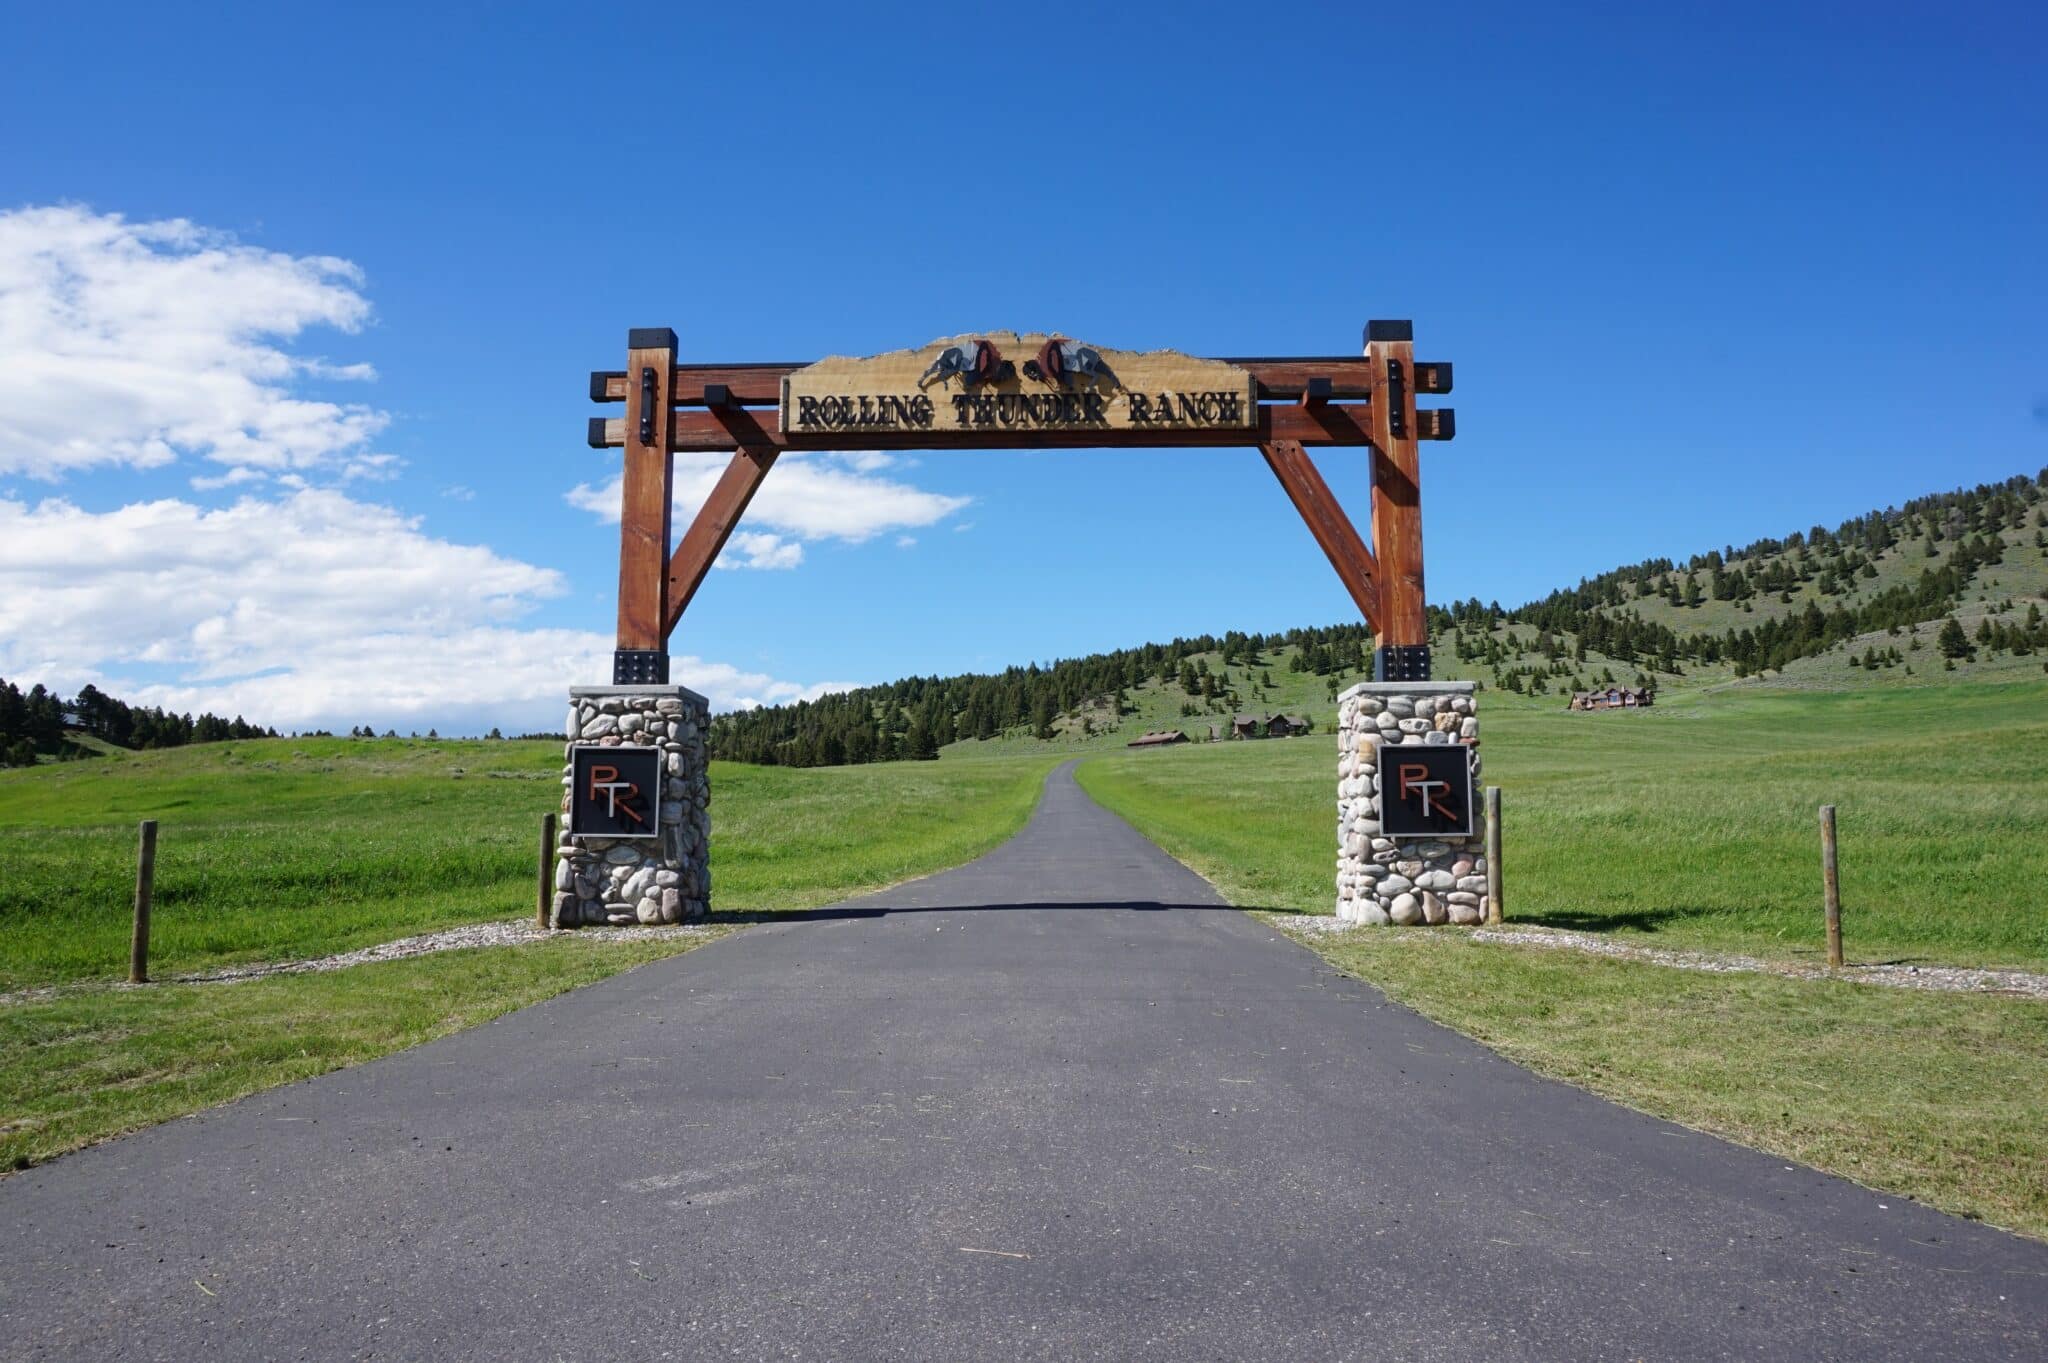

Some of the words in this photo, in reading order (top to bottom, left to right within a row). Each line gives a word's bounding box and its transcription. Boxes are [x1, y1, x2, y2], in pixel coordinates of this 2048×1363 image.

[797, 394, 930, 425] ROLLING
[952, 393, 1106, 424] THUNDER
[1127, 391, 1240, 423] RANCH
